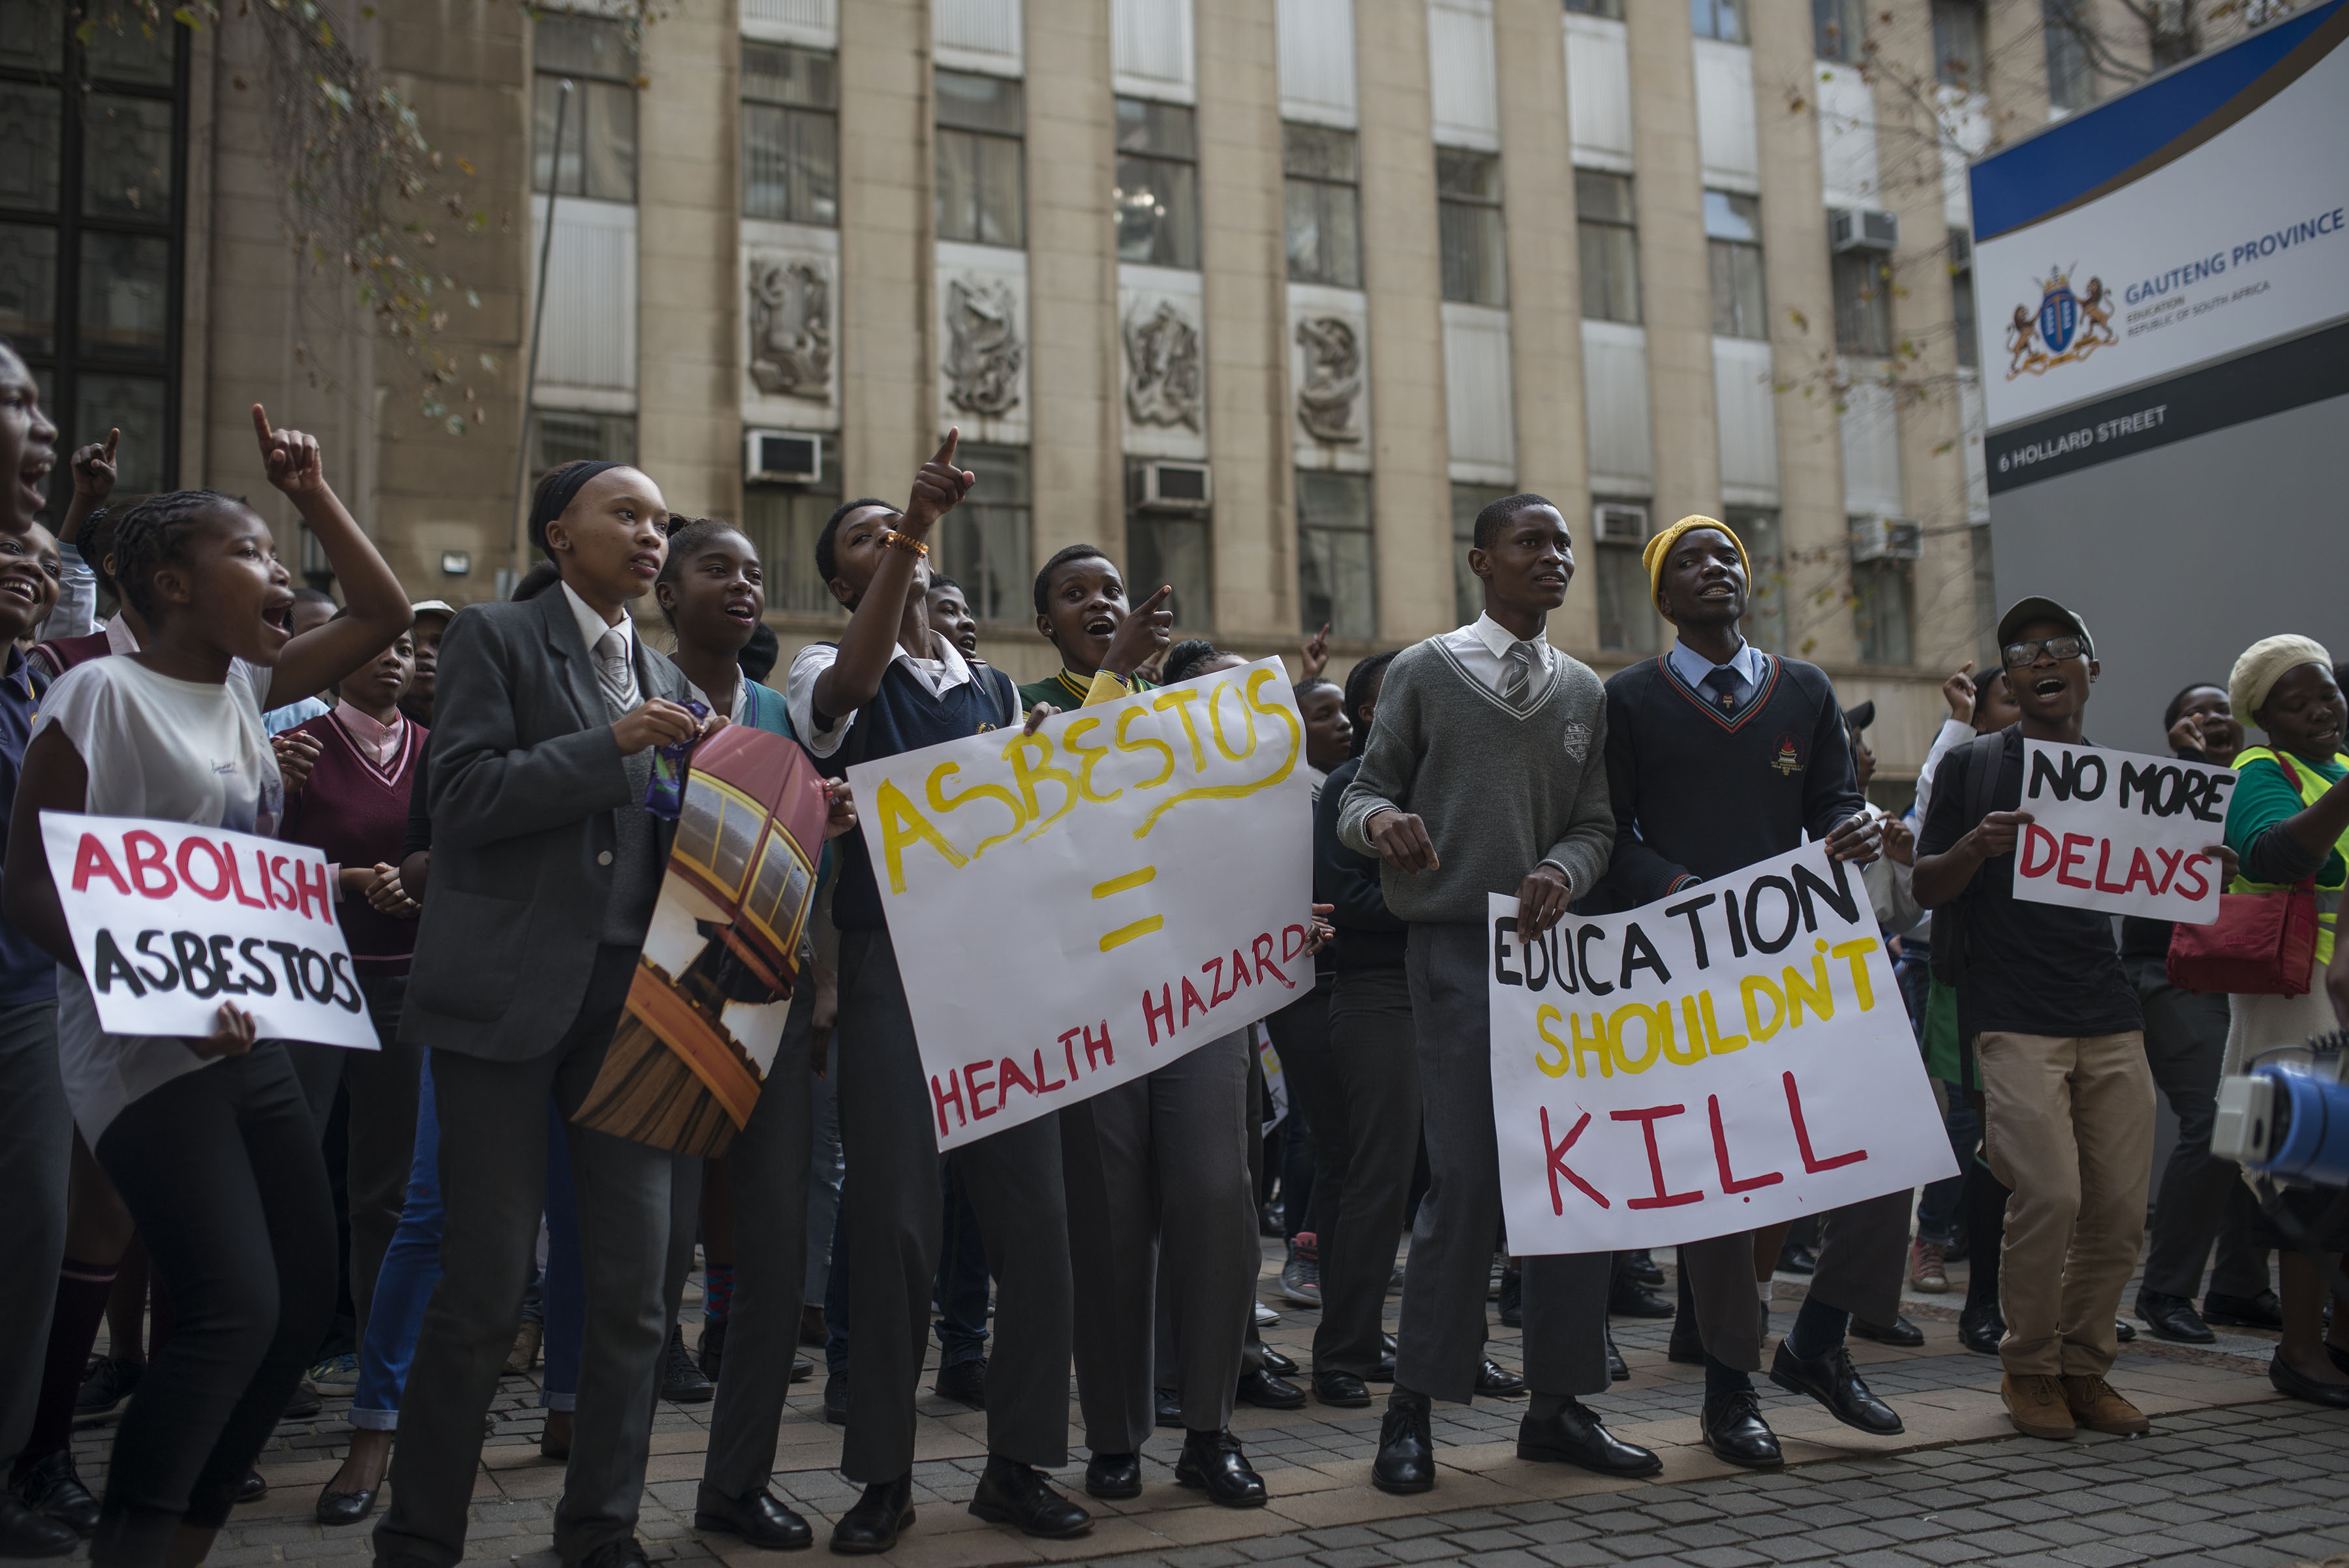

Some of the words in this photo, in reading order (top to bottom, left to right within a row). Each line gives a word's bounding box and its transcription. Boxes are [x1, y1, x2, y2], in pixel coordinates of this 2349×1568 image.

[2125, 251, 2226, 306] GAUTENG
[2232, 207, 2345, 267] PROVINCE
[2126, 296, 2185, 323] EDUCATION
[2127, 313, 2173, 337] REPUBLIC
[2175, 307, 2190, 322] OF
[2192, 295, 2228, 316] SOUTH
[2231, 281, 2271, 303] AFRICA
[1998, 453, 2010, 472] 6
[2014, 428, 2093, 469] HOLLARD
[2096, 405, 2167, 442] STREET
[877, 669, 1300, 894] ASBESTOS
[2028, 749, 2108, 801] NO
[2120, 760, 2236, 823] MORE
[72, 829, 333, 925] ABOLISH
[2020, 823, 2212, 901] DELAYS
[95, 929, 362, 1015] ASBESTOS
[1495, 854, 1860, 996] EDUCATION
[931, 1019, 1114, 1138] HEALTH
[1143, 925, 1305, 1046] HAZARD
[1535, 938, 1878, 1078] SHOULDN'T
[1540, 1071, 1867, 1216] KILL
